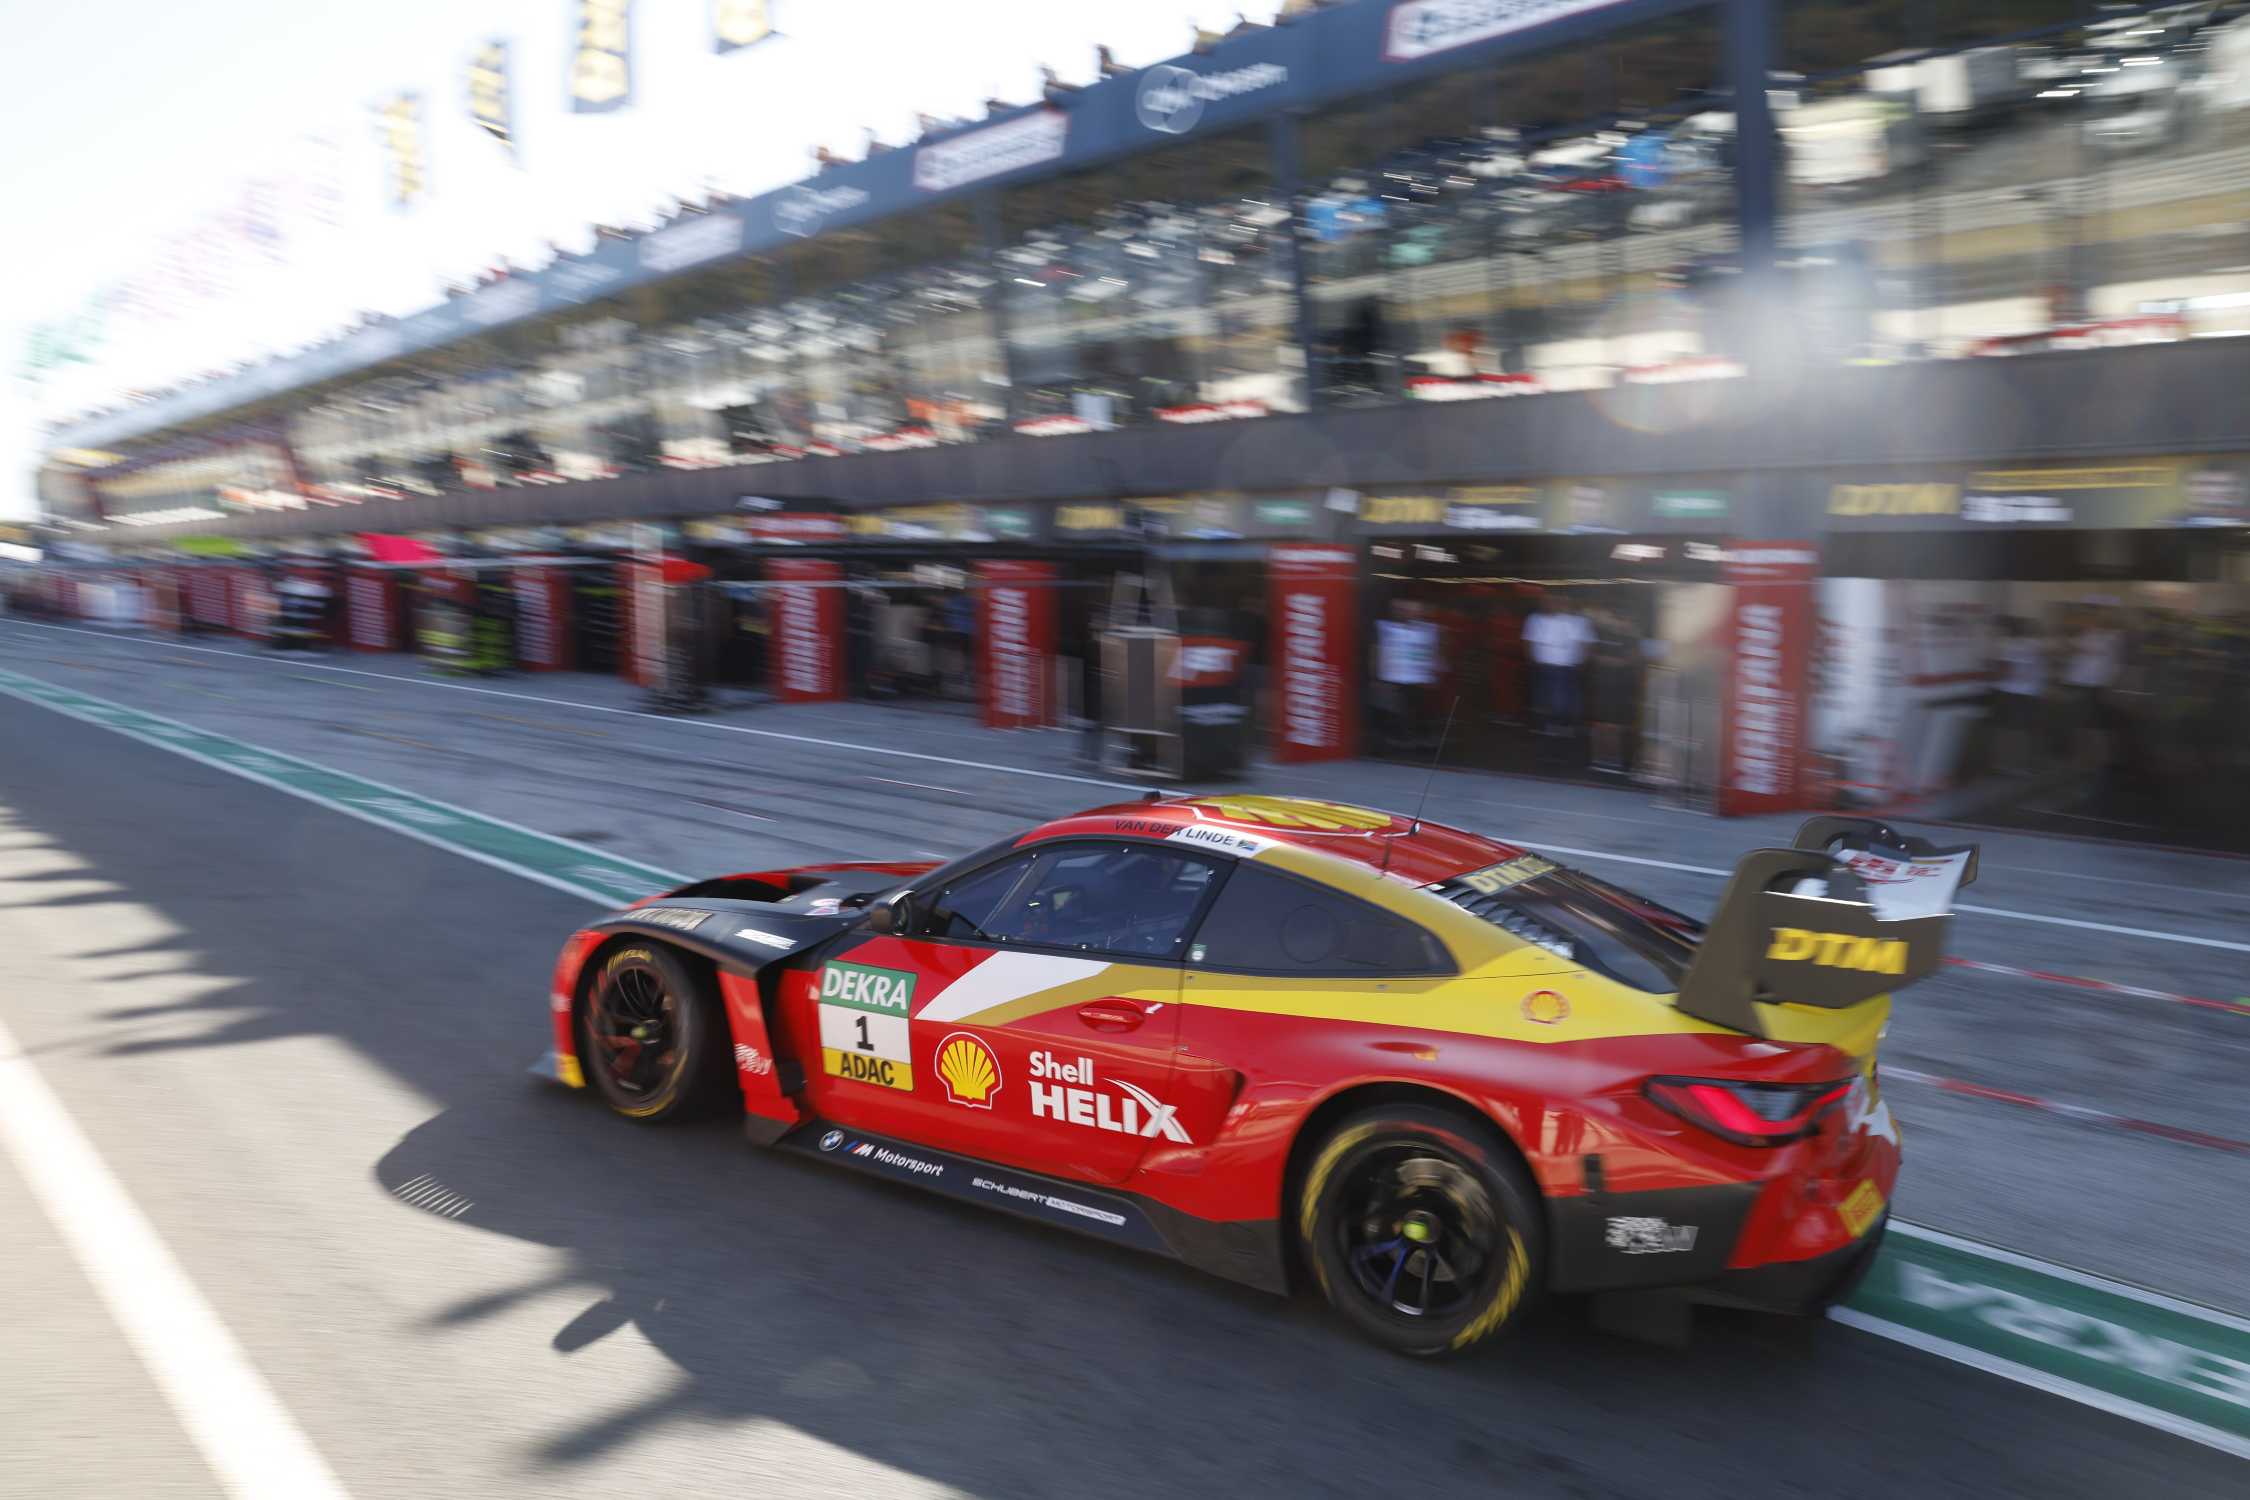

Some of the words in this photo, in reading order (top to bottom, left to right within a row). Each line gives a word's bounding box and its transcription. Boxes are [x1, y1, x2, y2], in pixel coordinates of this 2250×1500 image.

[1114, 819, 1145, 832] VAN
[1149, 821, 1182, 836] DER
[1186, 828, 1234, 847] LINDE
[1765, 927, 1910, 975] DTM
[822, 967, 908, 1011] DEKRA
[855, 1015, 875, 1052] 1
[840, 1052, 895, 1086] ADAC
[1028, 1050, 1094, 1087] Shell
[1027, 1077, 1194, 1145] HELIX
[873, 1147, 945, 1177] Motorsport
[971, 1177, 1048, 1204] SCHUBERT
